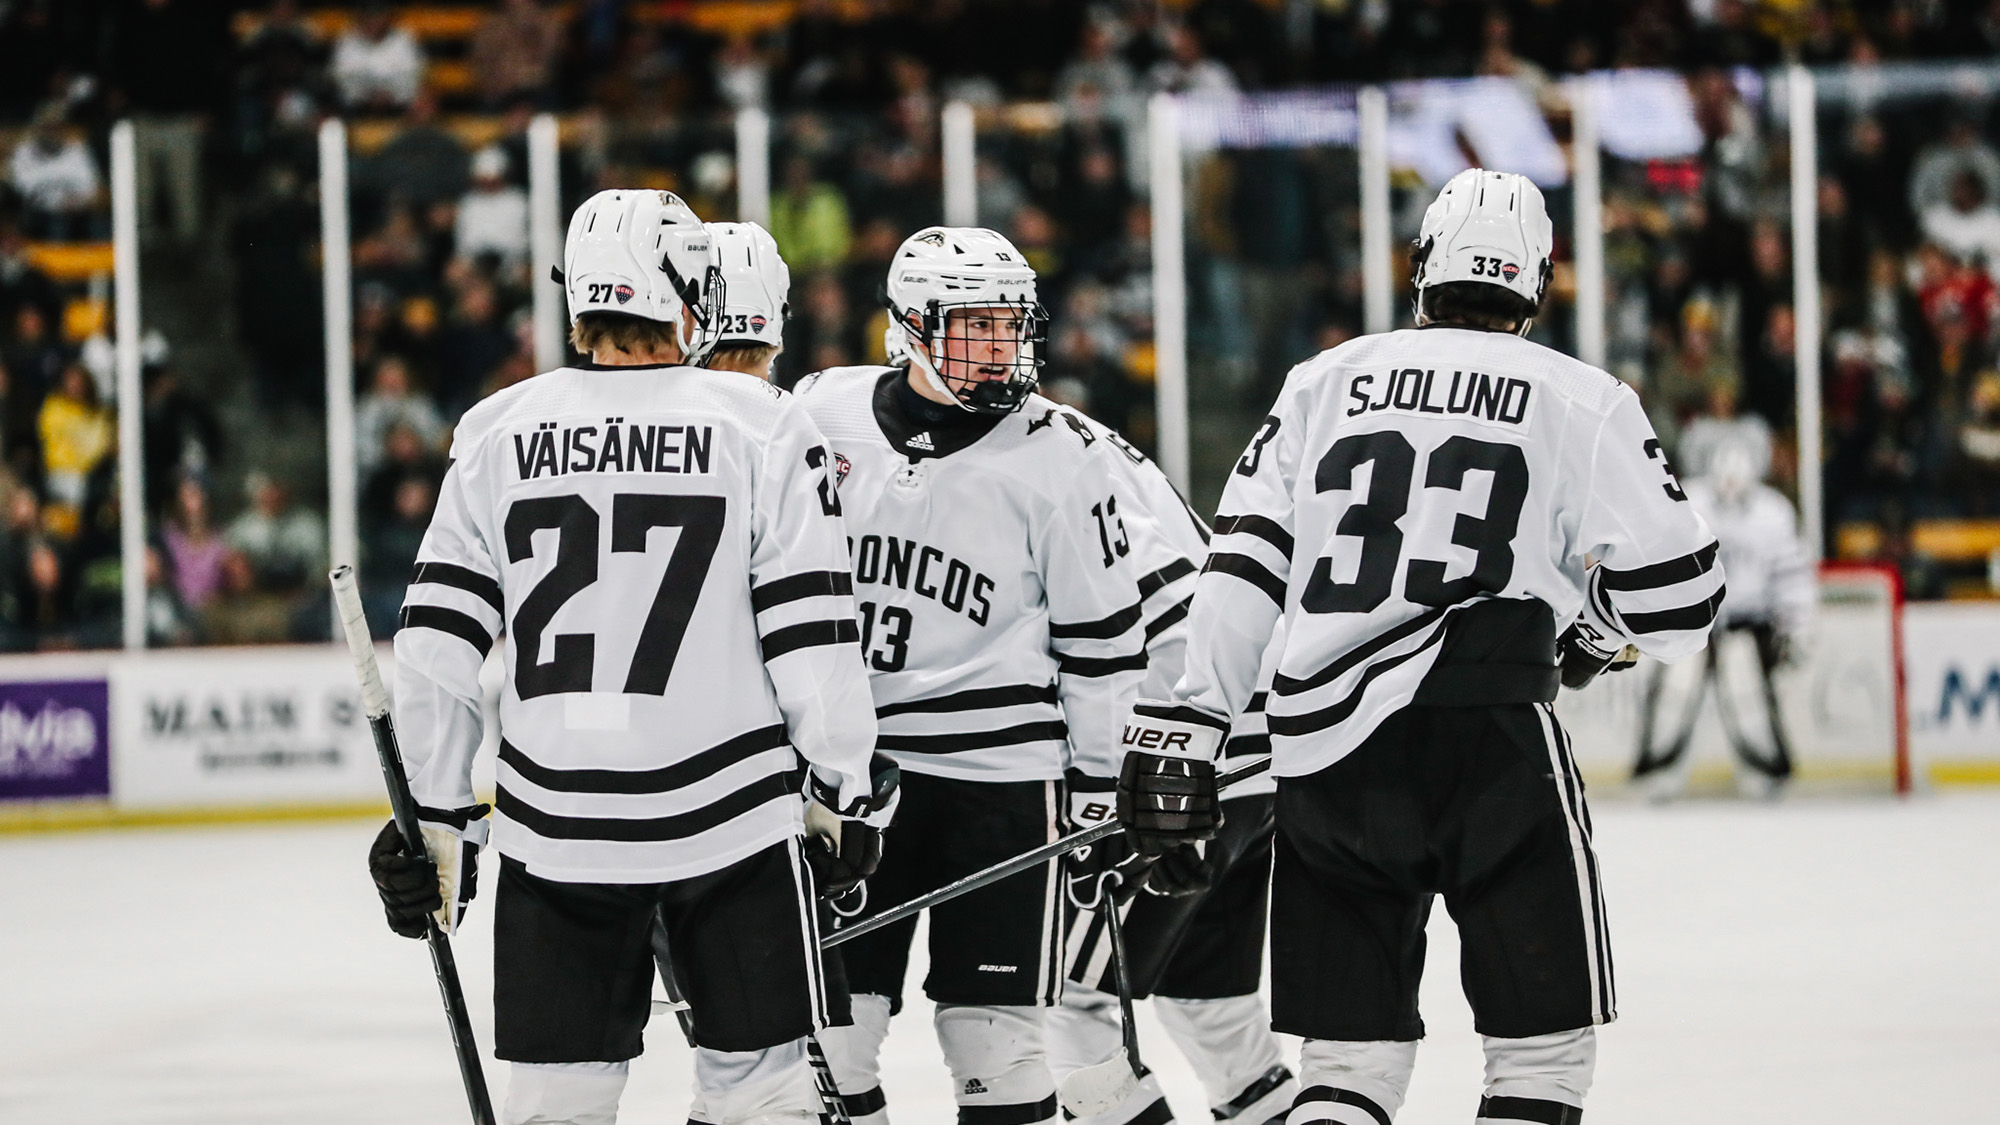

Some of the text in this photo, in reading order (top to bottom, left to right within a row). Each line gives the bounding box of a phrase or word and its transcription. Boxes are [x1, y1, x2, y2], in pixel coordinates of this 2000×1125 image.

[995, 253, 1012, 262] 13
[1471, 255, 1502, 278] 33
[588, 283, 613, 304] 27
[720, 314, 747, 334] 23
[1347, 368, 1532, 425] SJOLUND
[513, 416, 713, 481] VÄISÄNEN
[1091, 494, 1130, 569] 13
[1300, 430, 1529, 615] 33
[503, 493, 728, 702] 27
[847, 534, 996, 628] ONCOS
[859, 600, 914, 673] 13
[977, 964, 1018, 973] BAUER
